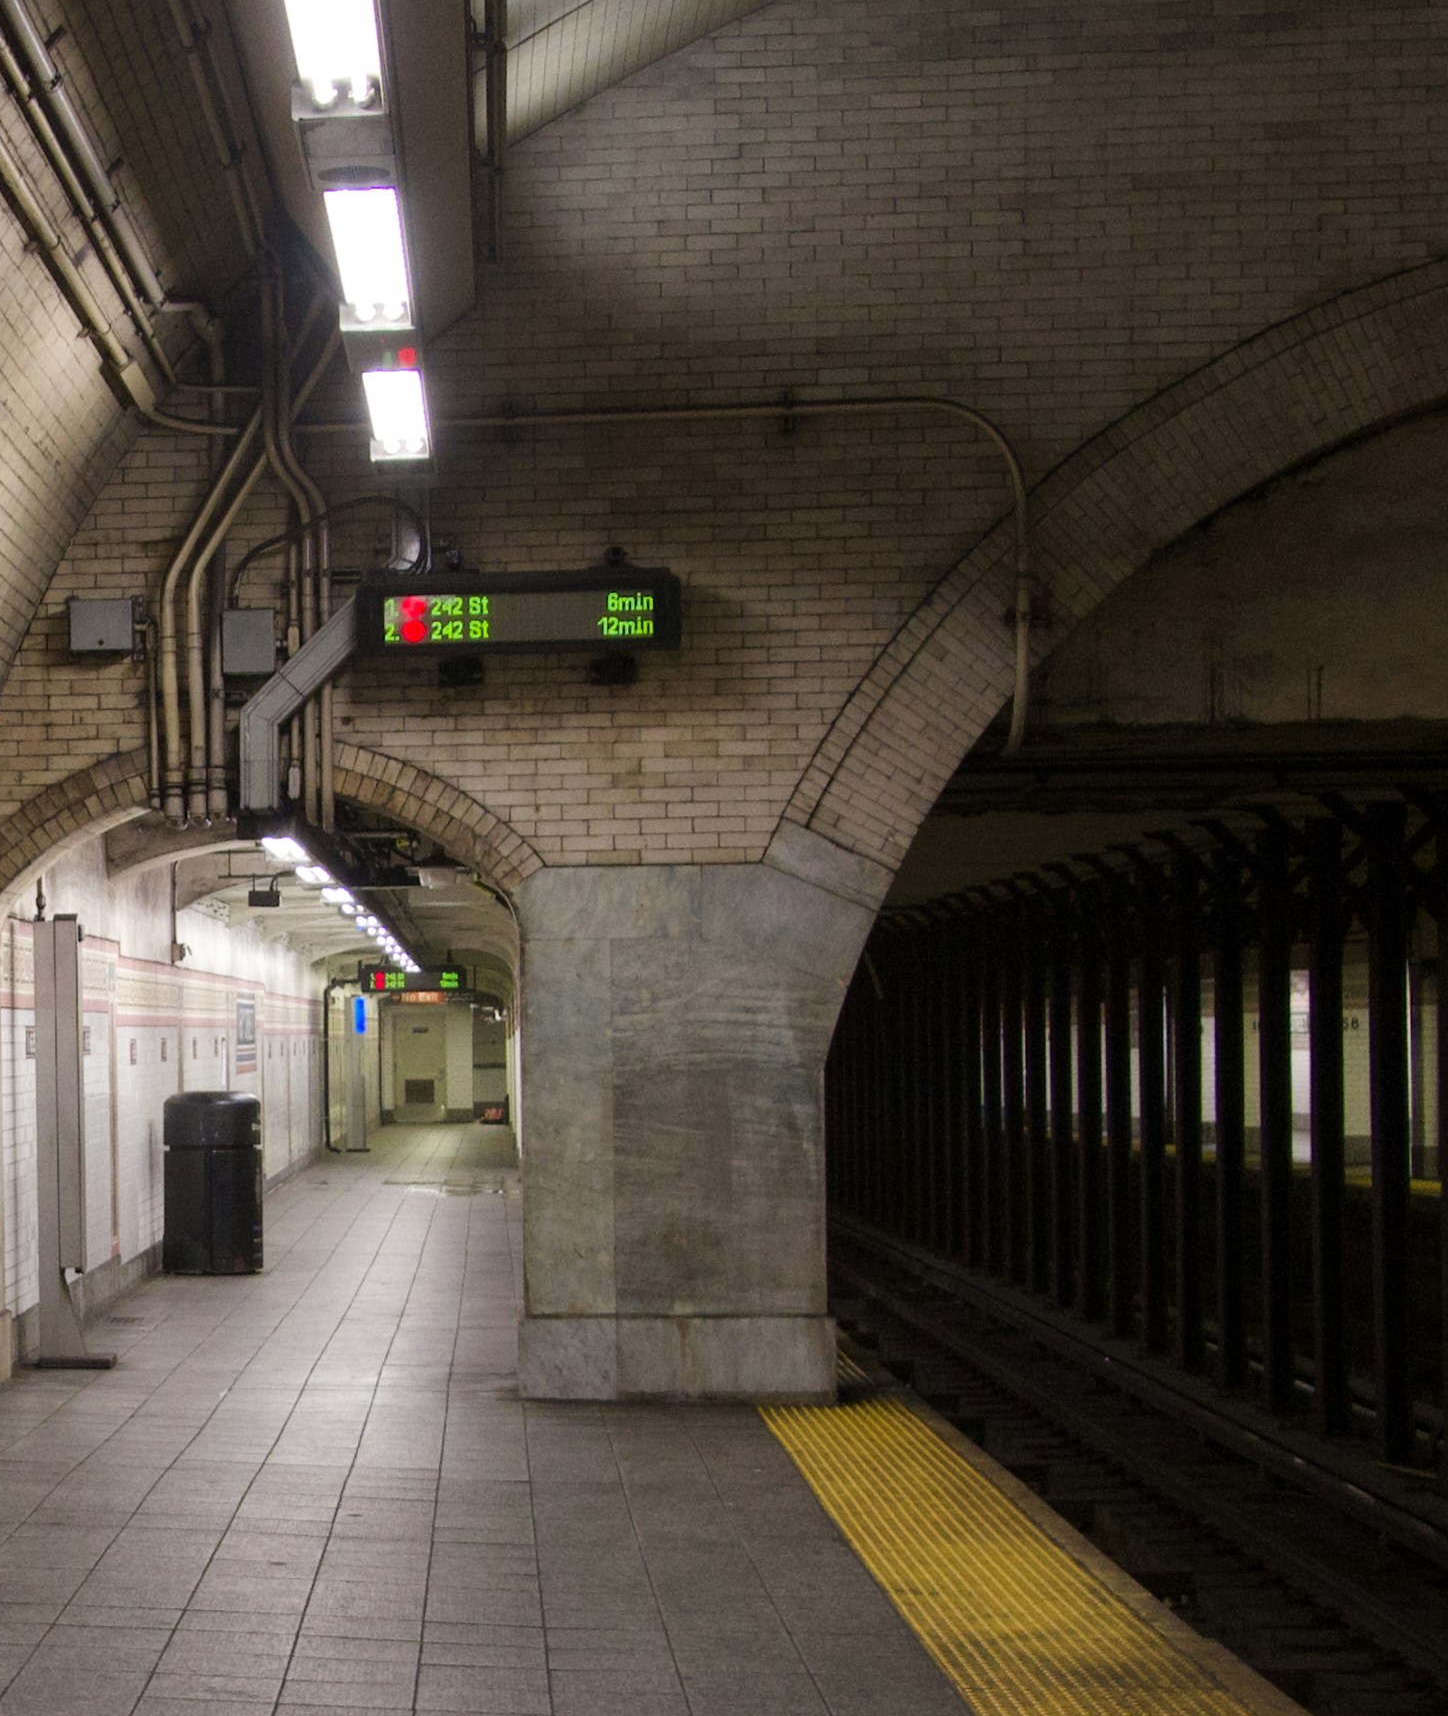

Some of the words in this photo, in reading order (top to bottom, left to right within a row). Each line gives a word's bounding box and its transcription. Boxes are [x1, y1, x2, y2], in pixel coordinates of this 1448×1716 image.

[431, 596, 463, 615] 242
[468, 595, 489, 615] St
[607, 592, 654, 612] 6min
[385, 623, 400, 641] 2.
[431, 621, 463, 639] 242
[469, 620, 489, 639] St
[597, 616, 654, 636] 12min
[401, 992, 416, 1002] No
[419, 992, 438, 1002] Exit
